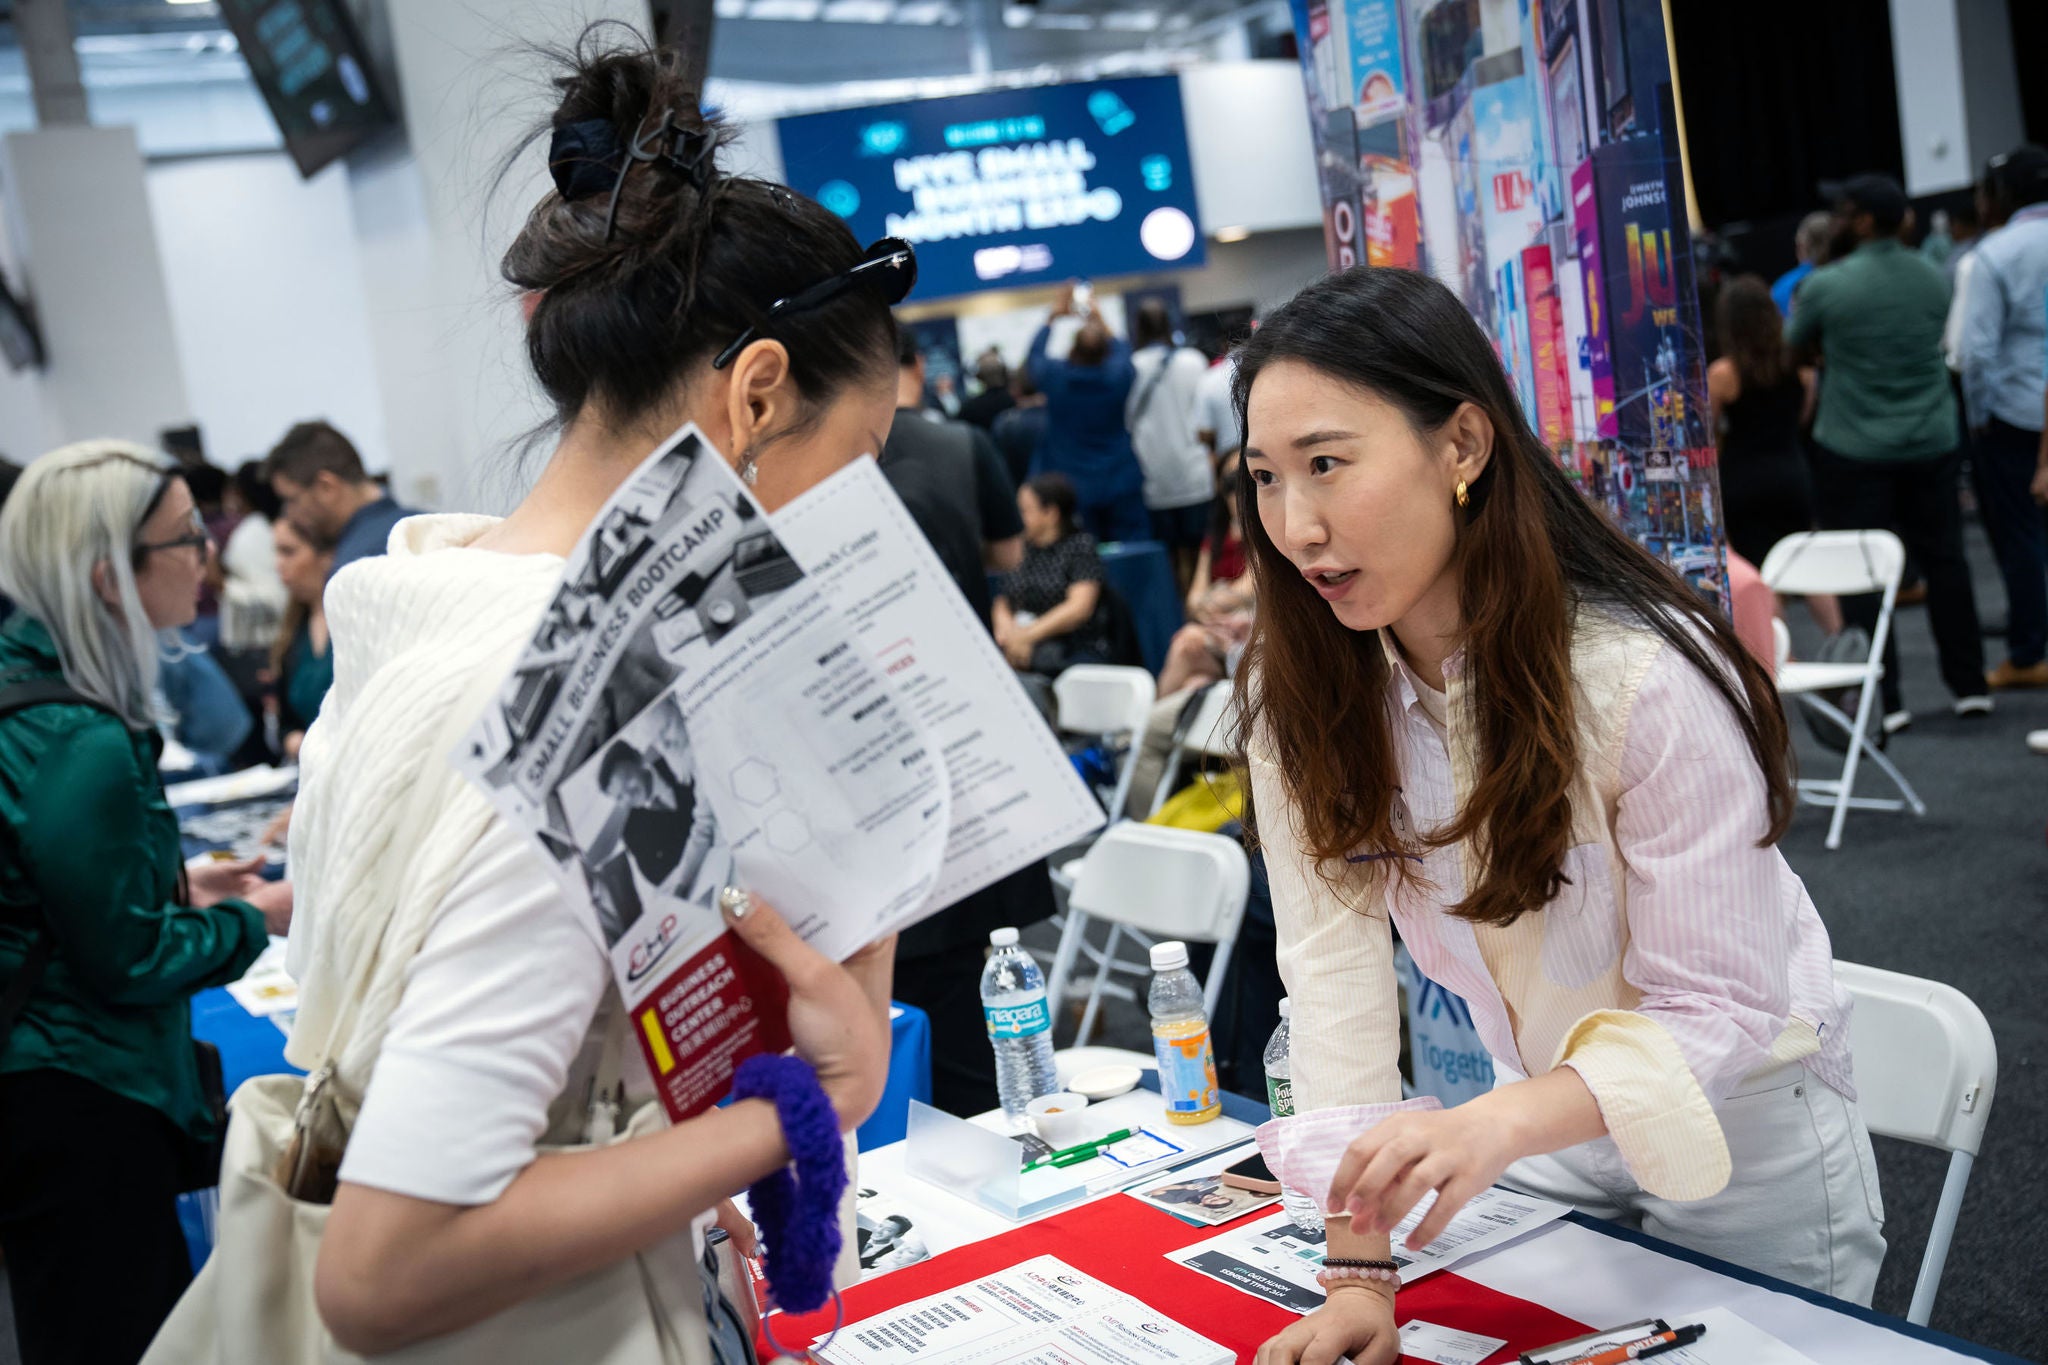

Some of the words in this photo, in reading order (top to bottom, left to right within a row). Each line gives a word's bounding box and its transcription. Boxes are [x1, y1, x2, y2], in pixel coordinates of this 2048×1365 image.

[526, 716, 574, 787] SMALL
[567, 609, 631, 710] BUSINESS
[627, 507, 725, 608] BOOTCAMP
[659, 953, 726, 1012] BUSINESS
[665, 967, 735, 1027] OUTREACH
[670, 997, 725, 1043] CENTER
[989, 1003, 1042, 1025] niagara
[1219, 1268, 1251, 1284] BUSINESS
[1247, 1272, 1267, 1283] EXPO
[1264, 1279, 1291, 1292] MONTH
[1250, 1281, 1270, 1292] SMALL
[1268, 1288, 1286, 1298] NYC
